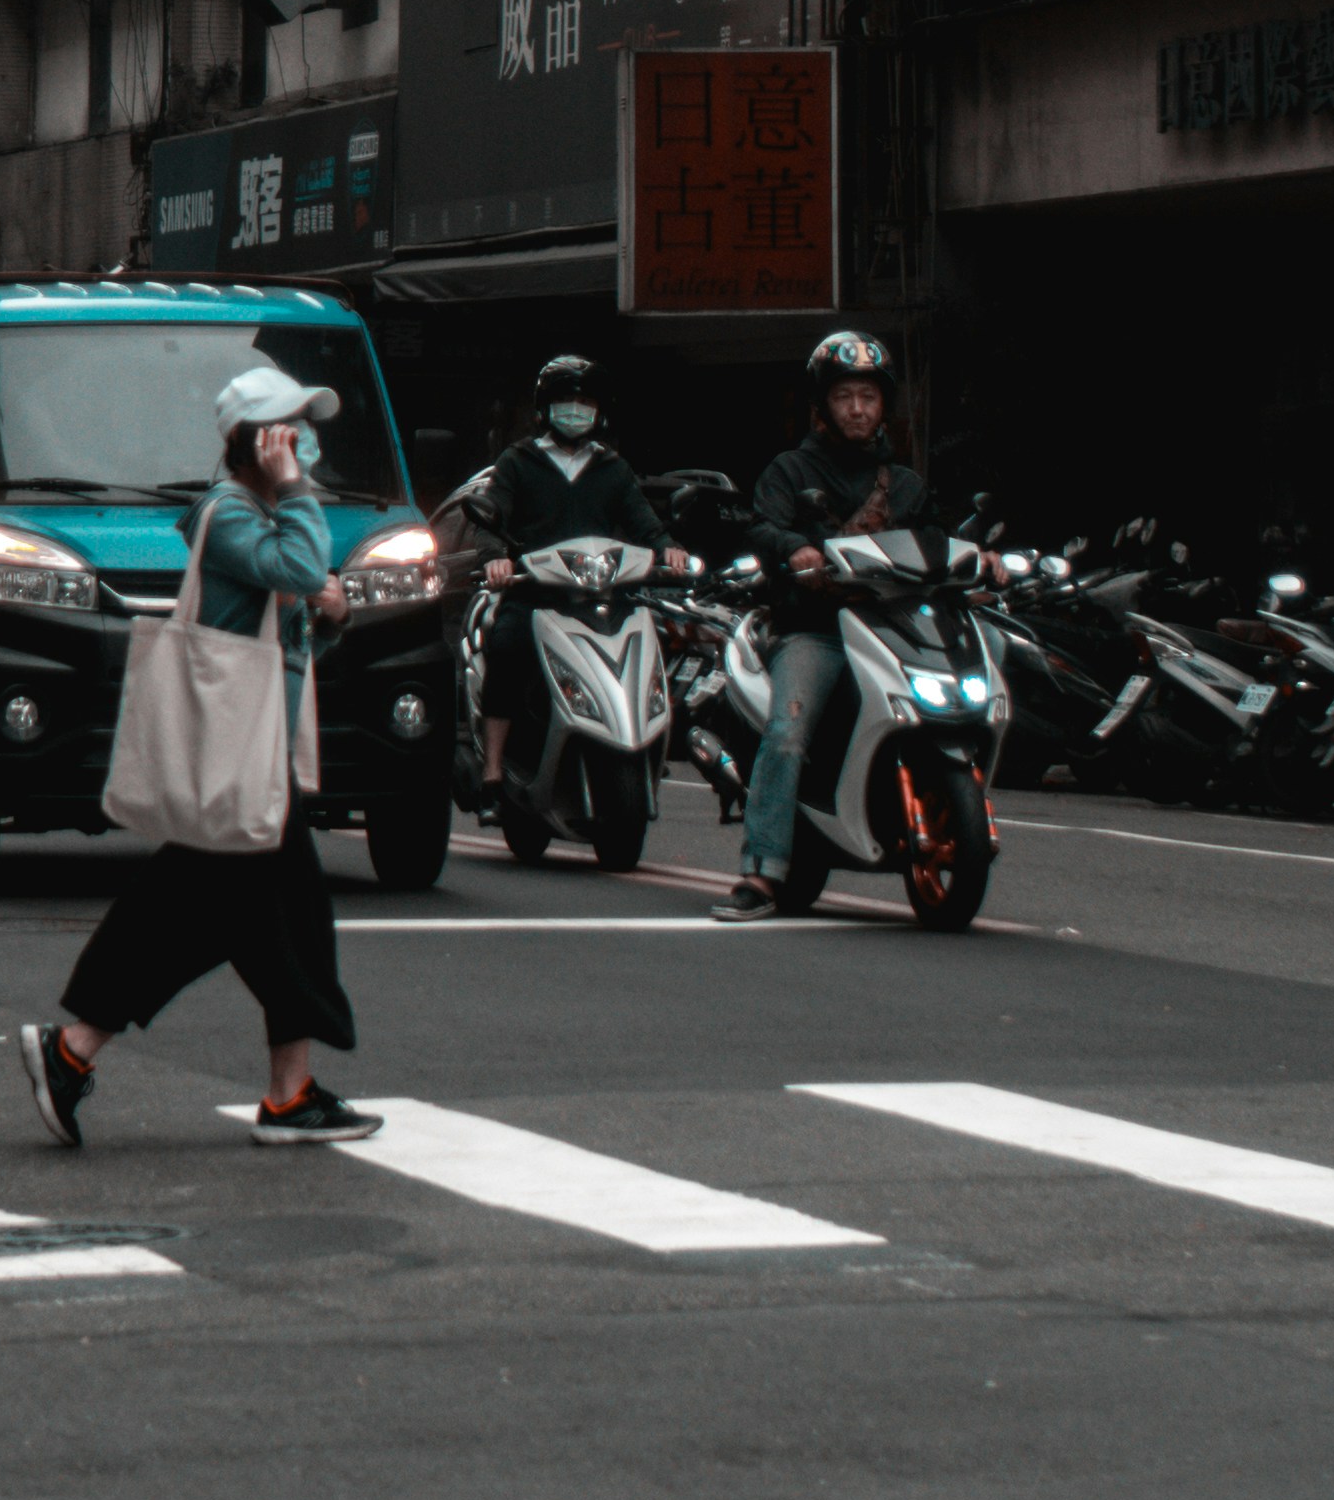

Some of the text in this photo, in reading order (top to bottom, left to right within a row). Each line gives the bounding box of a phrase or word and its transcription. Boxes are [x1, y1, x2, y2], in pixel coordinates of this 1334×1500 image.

[655, 63, 815, 150] 日意
[160, 188, 214, 235] SAMSUNG
[231, 152, 283, 250] 駭客
[642, 167, 816, 252] 古董
